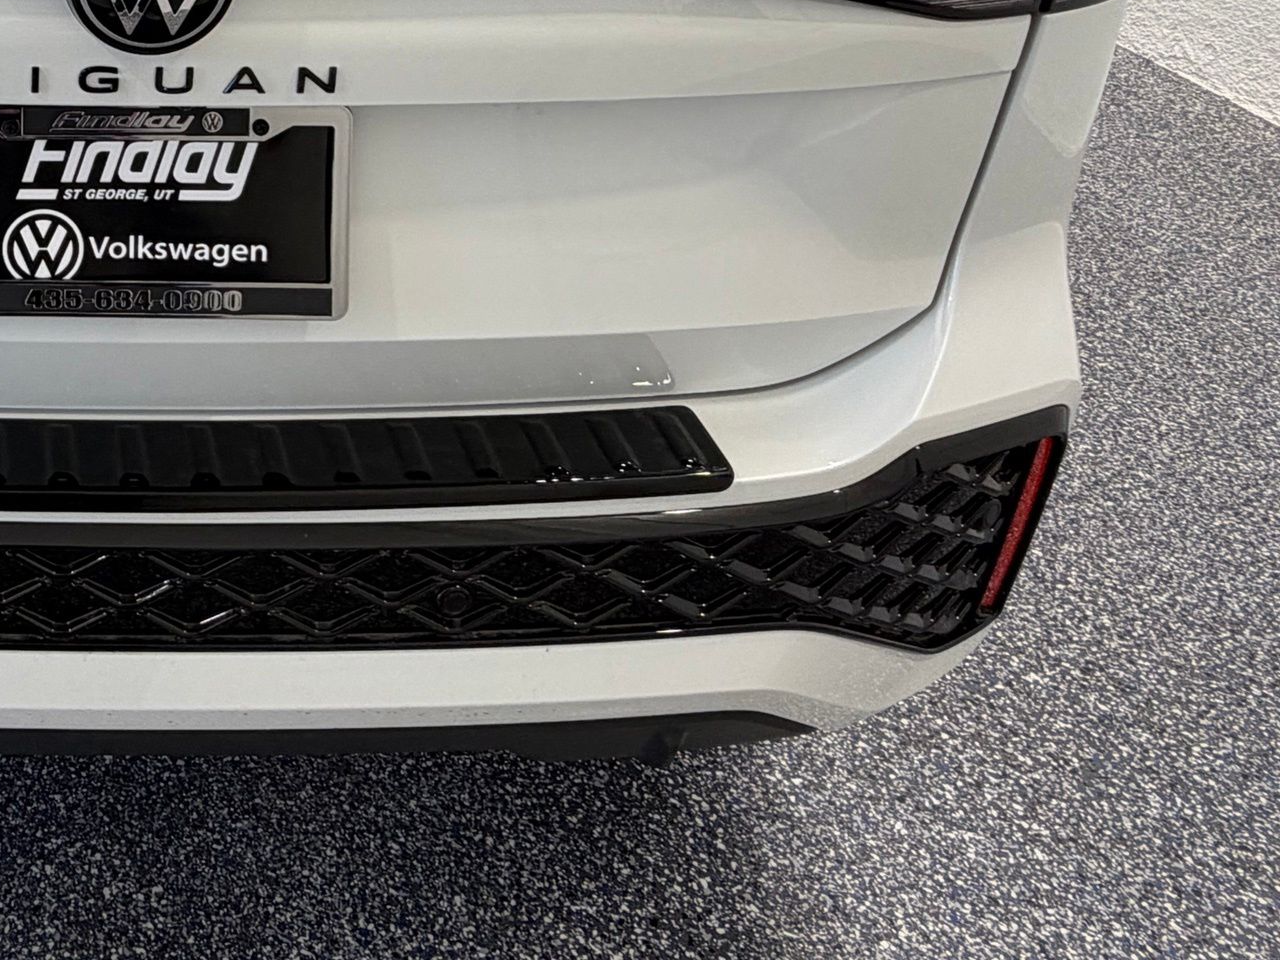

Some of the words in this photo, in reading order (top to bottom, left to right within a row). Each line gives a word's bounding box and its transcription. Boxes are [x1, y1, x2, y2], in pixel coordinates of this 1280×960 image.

[49, 111, 194, 132] Findlay
[21, 140, 258, 202] Findlay
[63, 188, 81, 200] ST
[85, 188, 149, 202] GEORGE,
[153, 189, 174, 200] UT
[88, 236, 268, 267] Volkswagen
[24, 288, 242, 311] 435-634-0900
